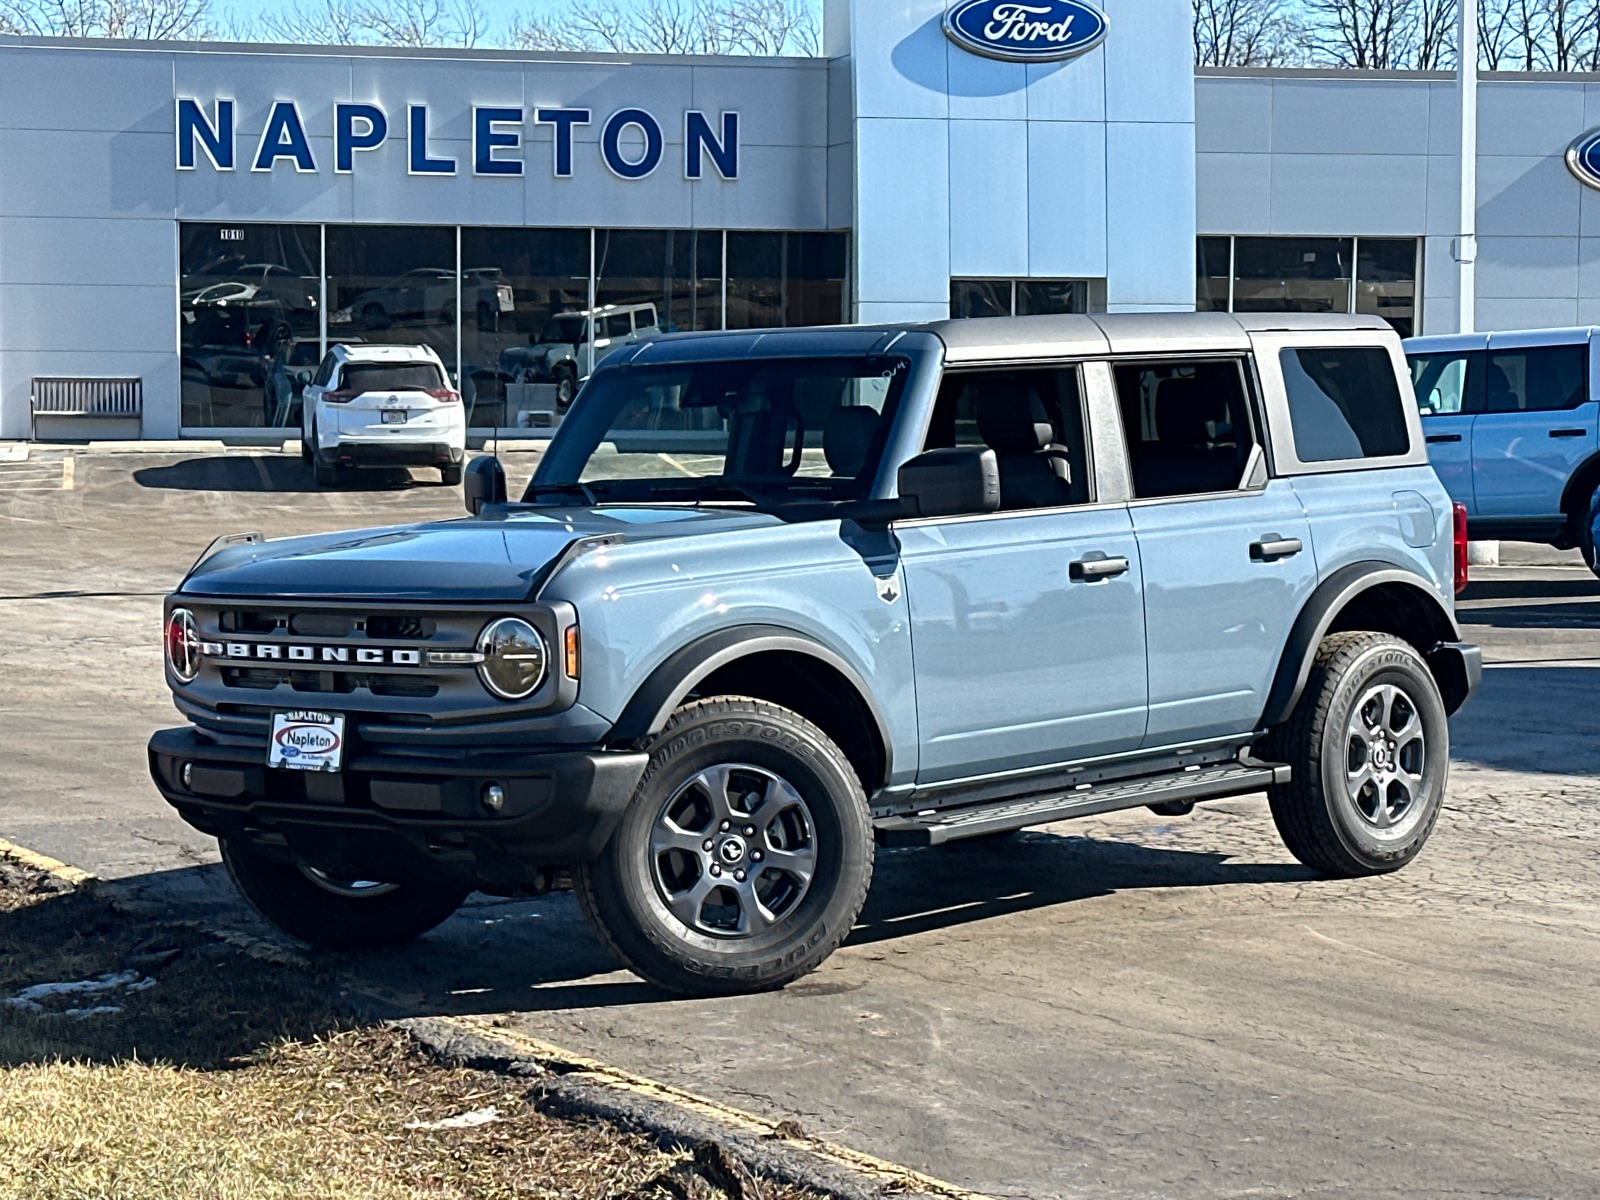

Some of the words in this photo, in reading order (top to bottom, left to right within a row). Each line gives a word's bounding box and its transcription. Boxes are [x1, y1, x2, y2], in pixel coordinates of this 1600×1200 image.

[984, 3, 1075, 42] Ford
[175, 98, 740, 180] NAPLETON
[221, 229, 245, 240] 1010
[227, 642, 420, 665] BRONCO
[288, 711, 332, 723] NAPLETON
[287, 730, 331, 748] Napleton
[684, 922, 827, 978] DUELER
